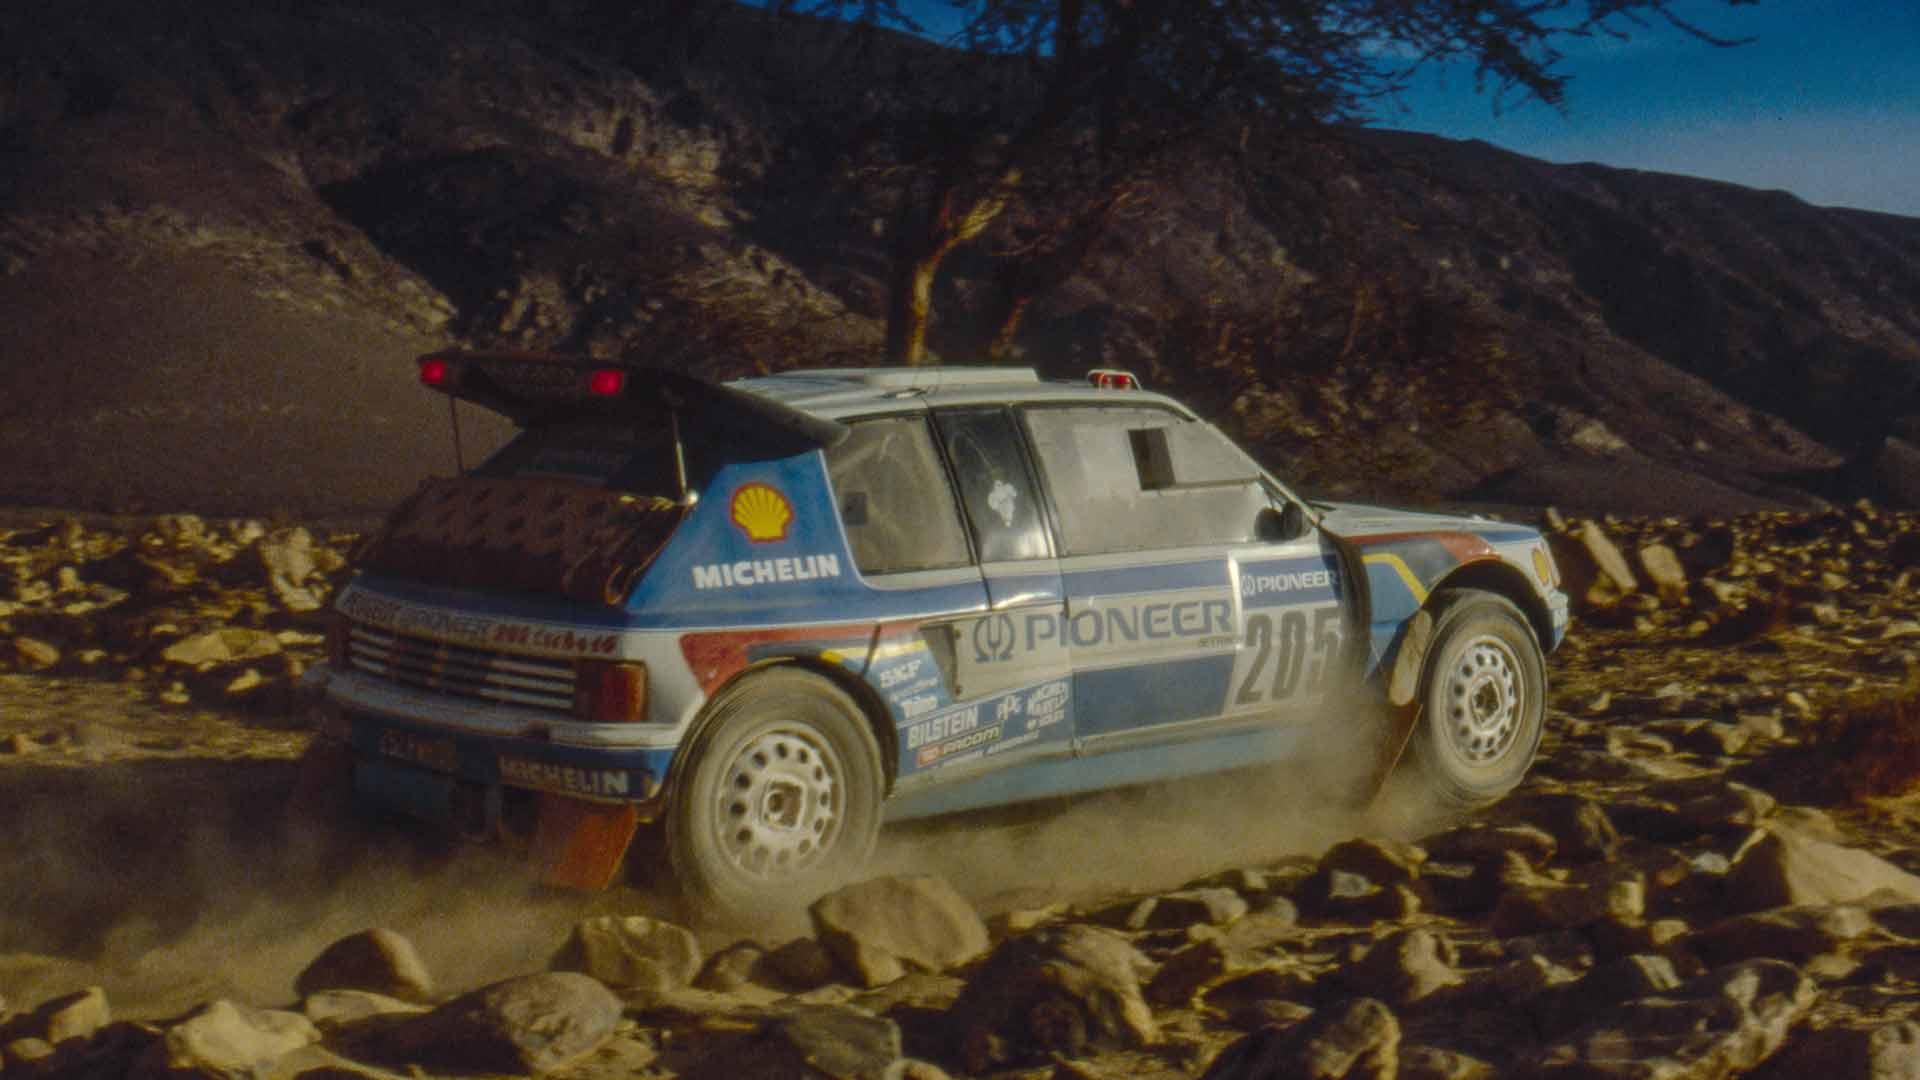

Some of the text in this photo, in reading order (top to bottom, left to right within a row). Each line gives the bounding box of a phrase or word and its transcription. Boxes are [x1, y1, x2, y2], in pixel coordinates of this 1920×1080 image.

[692, 553, 841, 590] MICHELIN
[1257, 570, 1339, 592] PIONEER
[1025, 600, 1233, 652] PIONEER
[1234, 607, 1343, 704] 205
[907, 705, 978, 750] BILSTEIN
